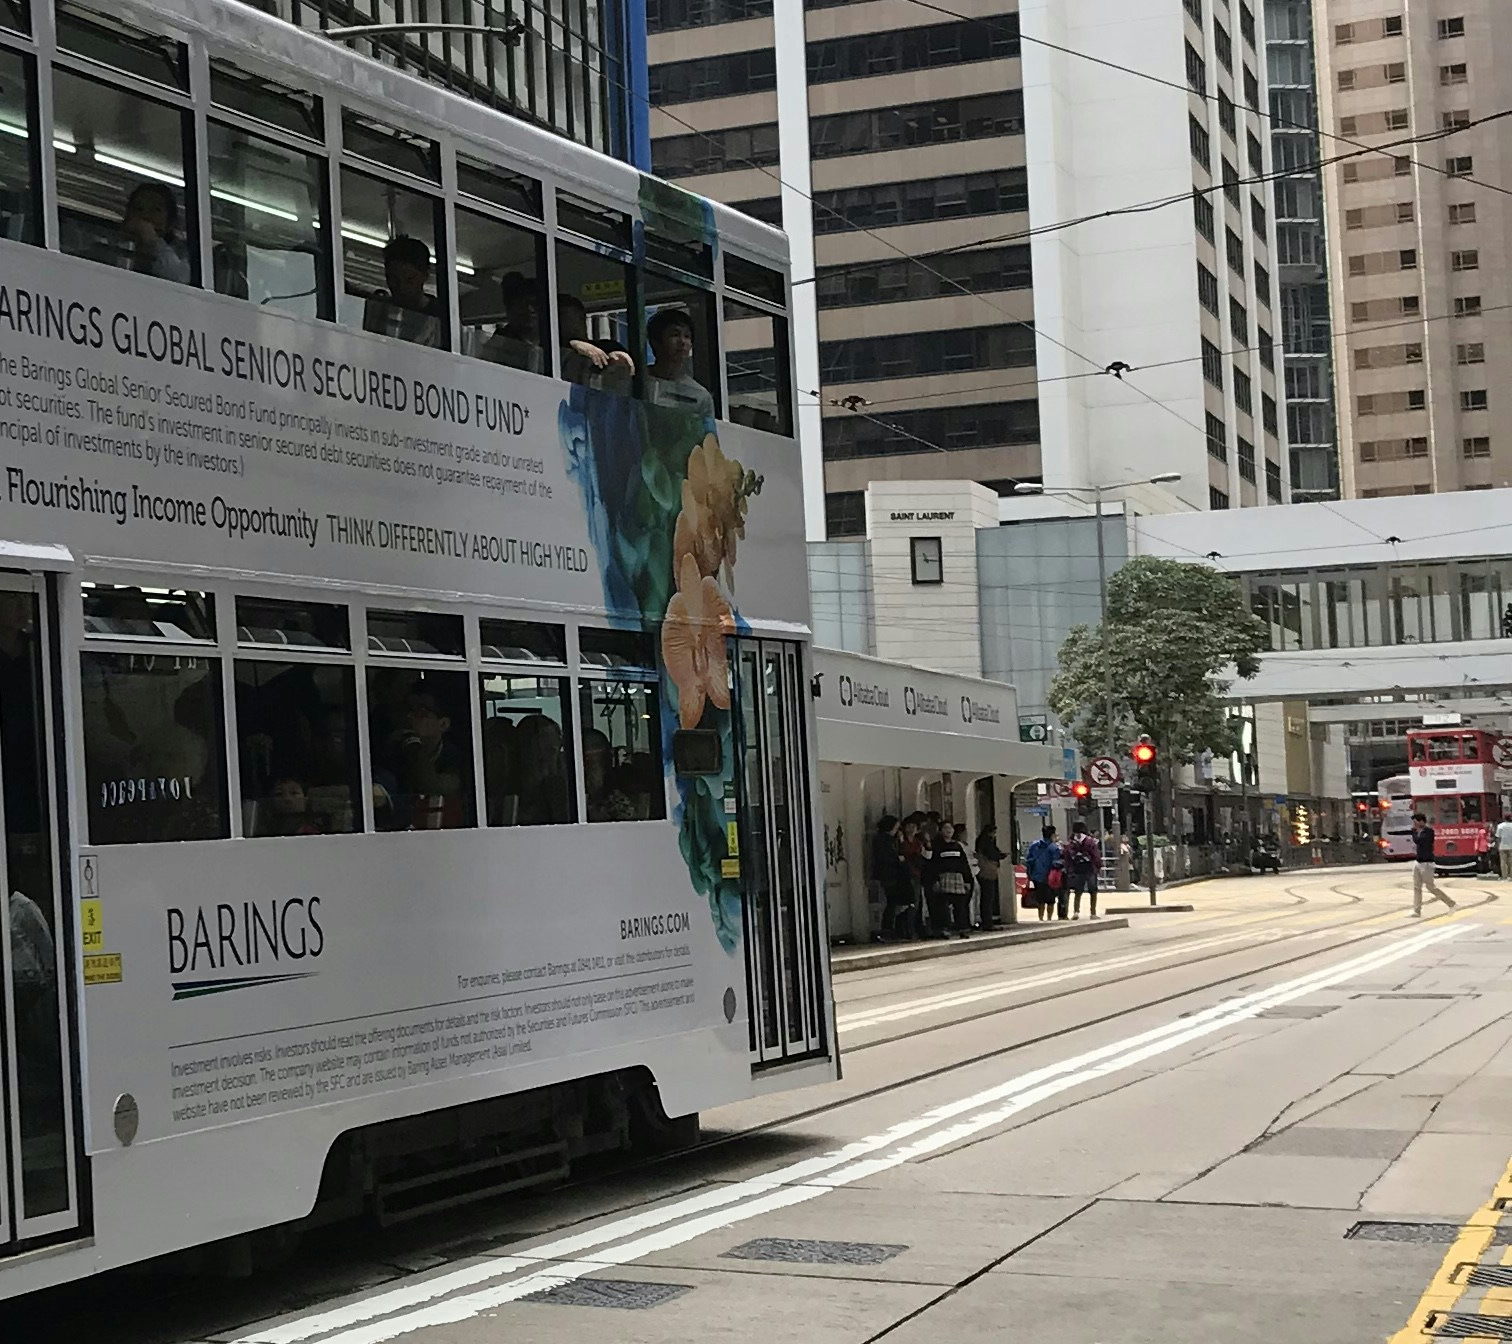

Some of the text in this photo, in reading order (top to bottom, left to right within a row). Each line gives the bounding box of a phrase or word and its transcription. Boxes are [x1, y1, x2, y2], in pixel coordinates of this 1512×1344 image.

[21, 356, 72, 389] Barings
[75, 366, 119, 394] Global
[122, 375, 162, 402] Senior
[165, 383, 213, 411] Secured
[216, 393, 246, 417] Bond
[249, 400, 276, 423] Fund
[111, 311, 215, 372] GLOBAL
[221, 337, 307, 391] SENIOR
[312, 358, 408, 412] SECURED
[414, 382, 470, 425] BOND
[45, 426, 60, 445] of
[63, 428, 142, 458] investments
[145, 441, 162, 466] by
[164, 445, 184, 465] the
[87, 400, 113, 423] The
[158, 413, 223, 442] investment
[225, 424, 236, 444] in
[239, 430, 273, 450] senior
[276, 439, 318, 458] secured
[320, 441, 343, 462] debt
[418, 460, 435, 478] not
[6, 466, 127, 525] Flourishing
[131, 483, 207, 526] Income
[211, 494, 318, 548] Opportunity
[890, 511, 955, 520] SAINT LAURENT
[326, 514, 588, 572] THINK DIFFERENTLY ABOUT HIGH YIELD
[167, 896, 324, 973] BARINGS
[620, 912, 691, 940] BARINGS.COM
